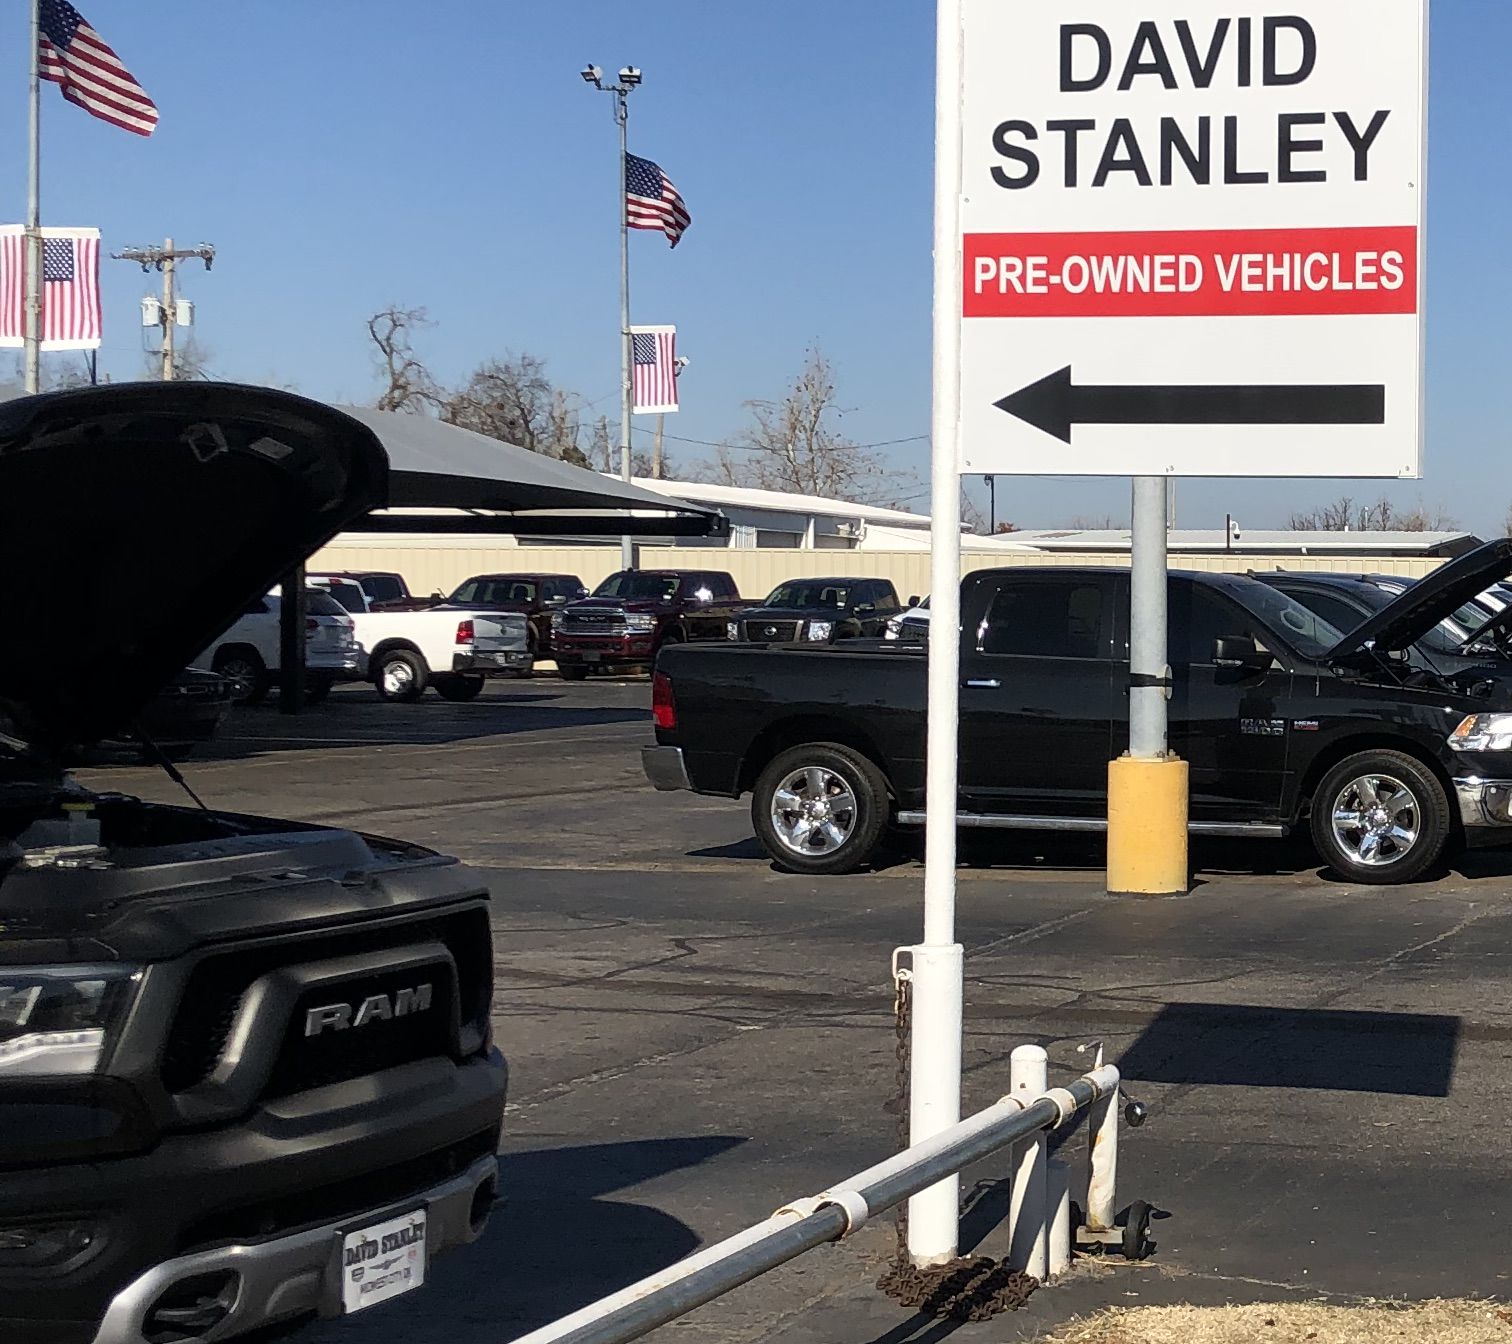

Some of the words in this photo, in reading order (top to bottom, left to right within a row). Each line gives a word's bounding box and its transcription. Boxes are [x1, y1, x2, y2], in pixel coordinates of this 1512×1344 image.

[1060, 15, 1317, 93] DAVID
[990, 110, 1391, 190] STANLEY
[974, 254, 1203, 294] PRE-OWNED
[1214, 251, 1404, 292] VEHICLES
[305, 983, 432, 1037] RAM
[344, 1239, 379, 1267] DAVID
[381, 1221, 425, 1255] STANLEY
